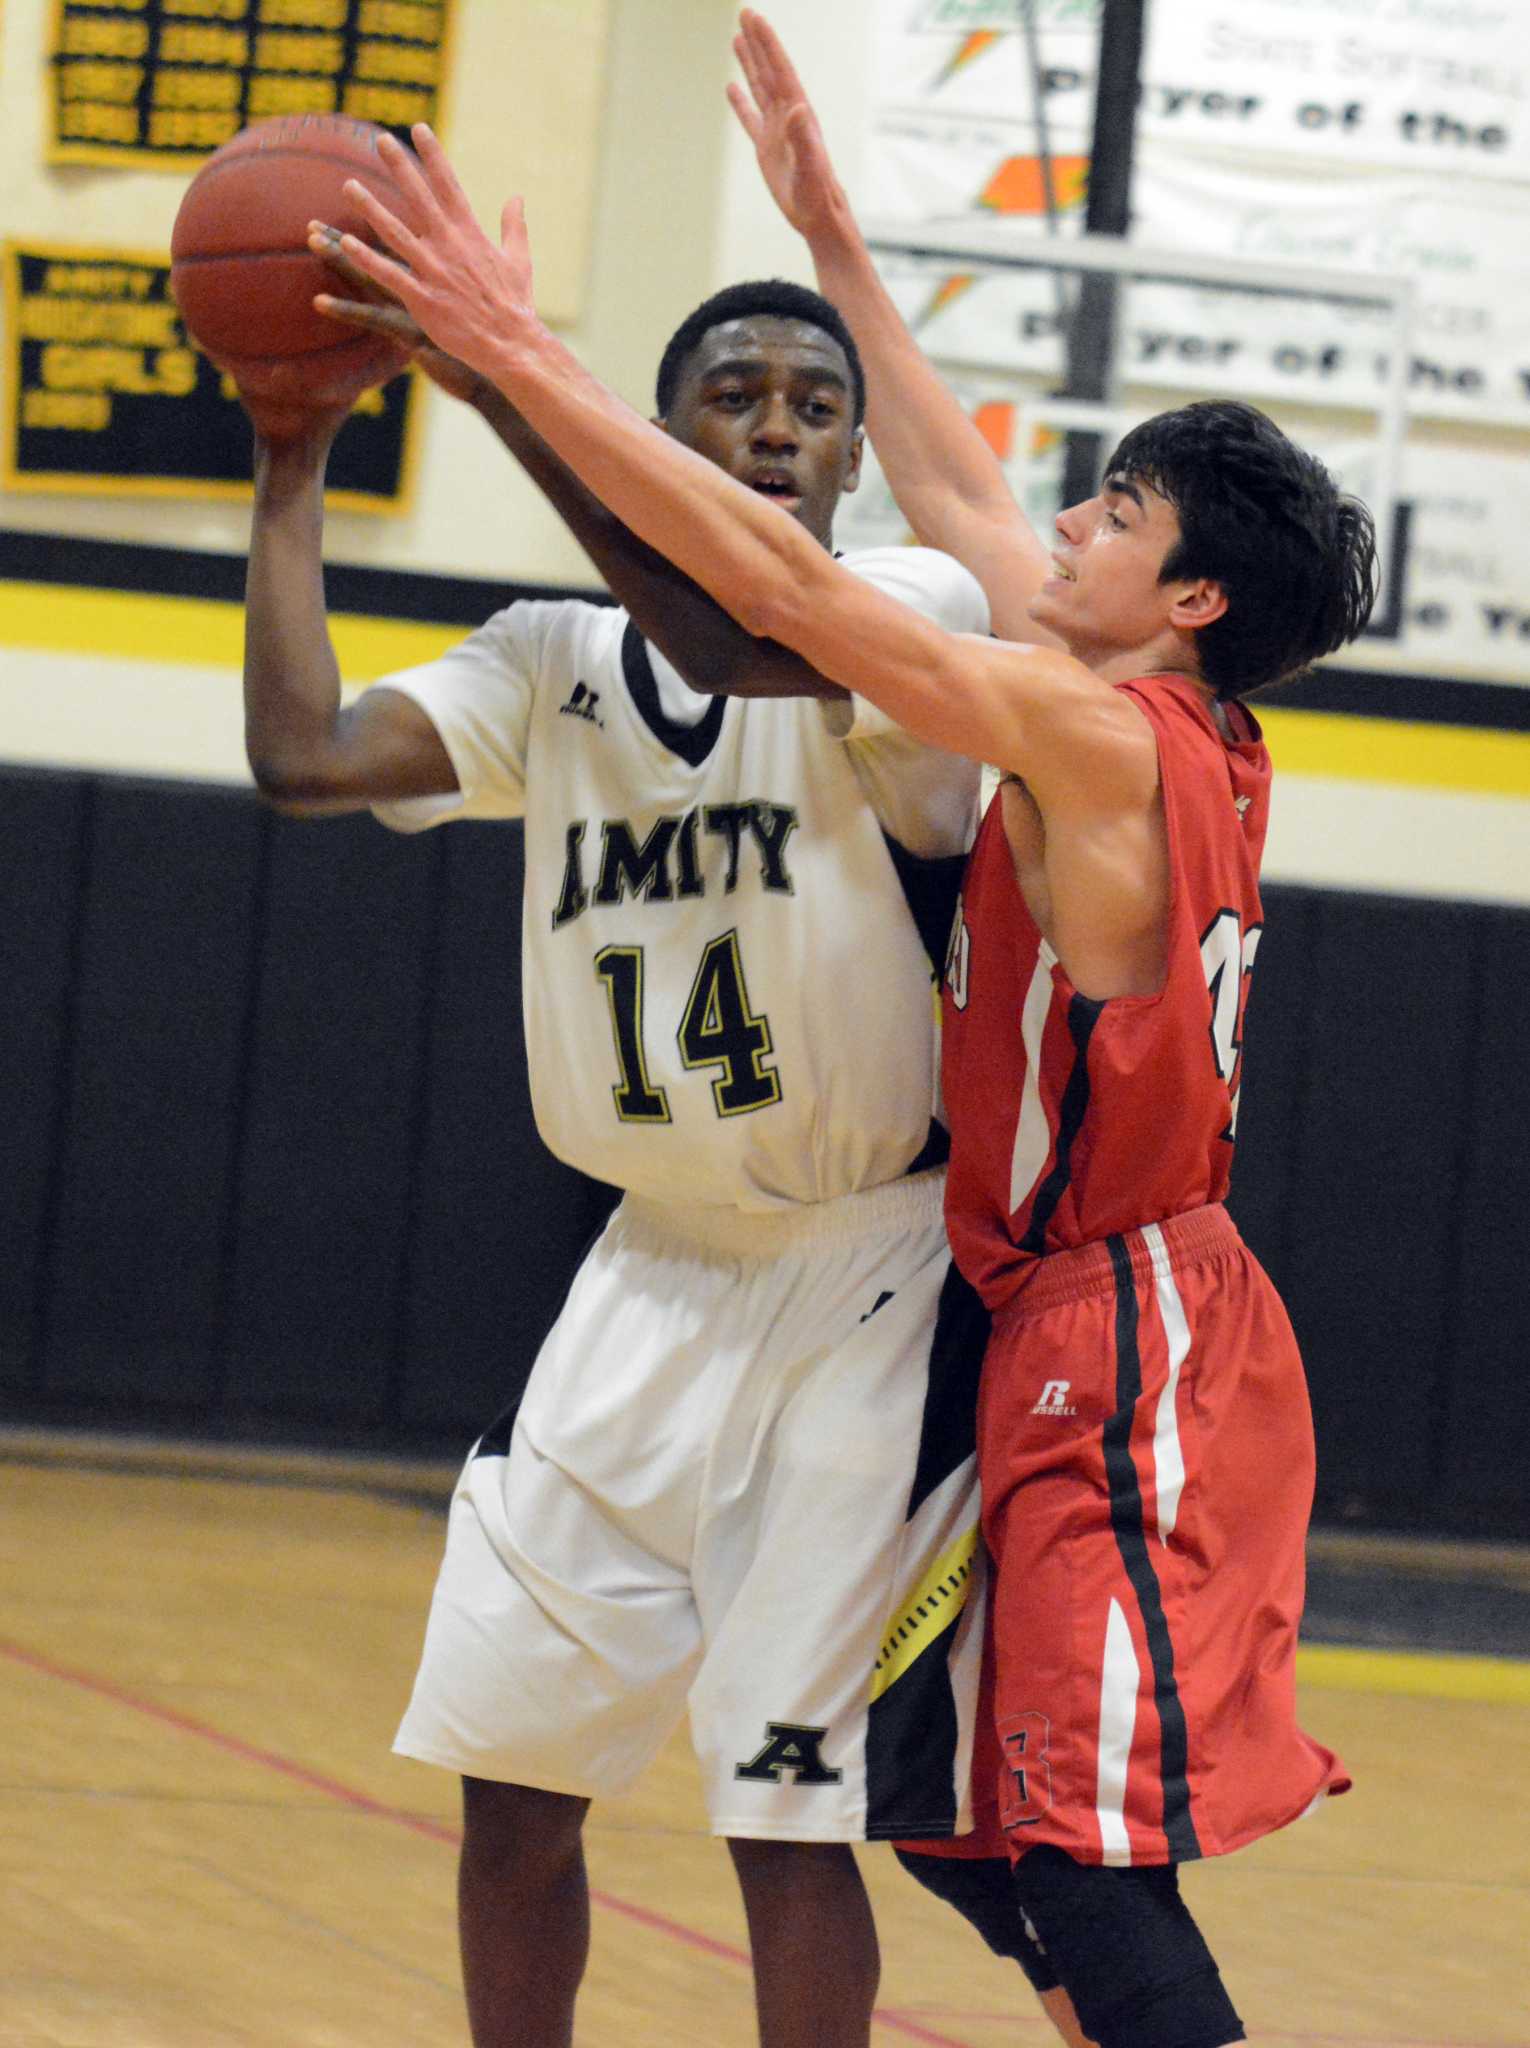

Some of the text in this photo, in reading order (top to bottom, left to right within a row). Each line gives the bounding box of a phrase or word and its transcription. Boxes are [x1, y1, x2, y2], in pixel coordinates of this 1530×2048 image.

[1295, 98, 1366, 133] of
[1397, 107, 1509, 153] the
[594, 927, 783, 1124] 14
[734, 1721, 843, 1785] A
